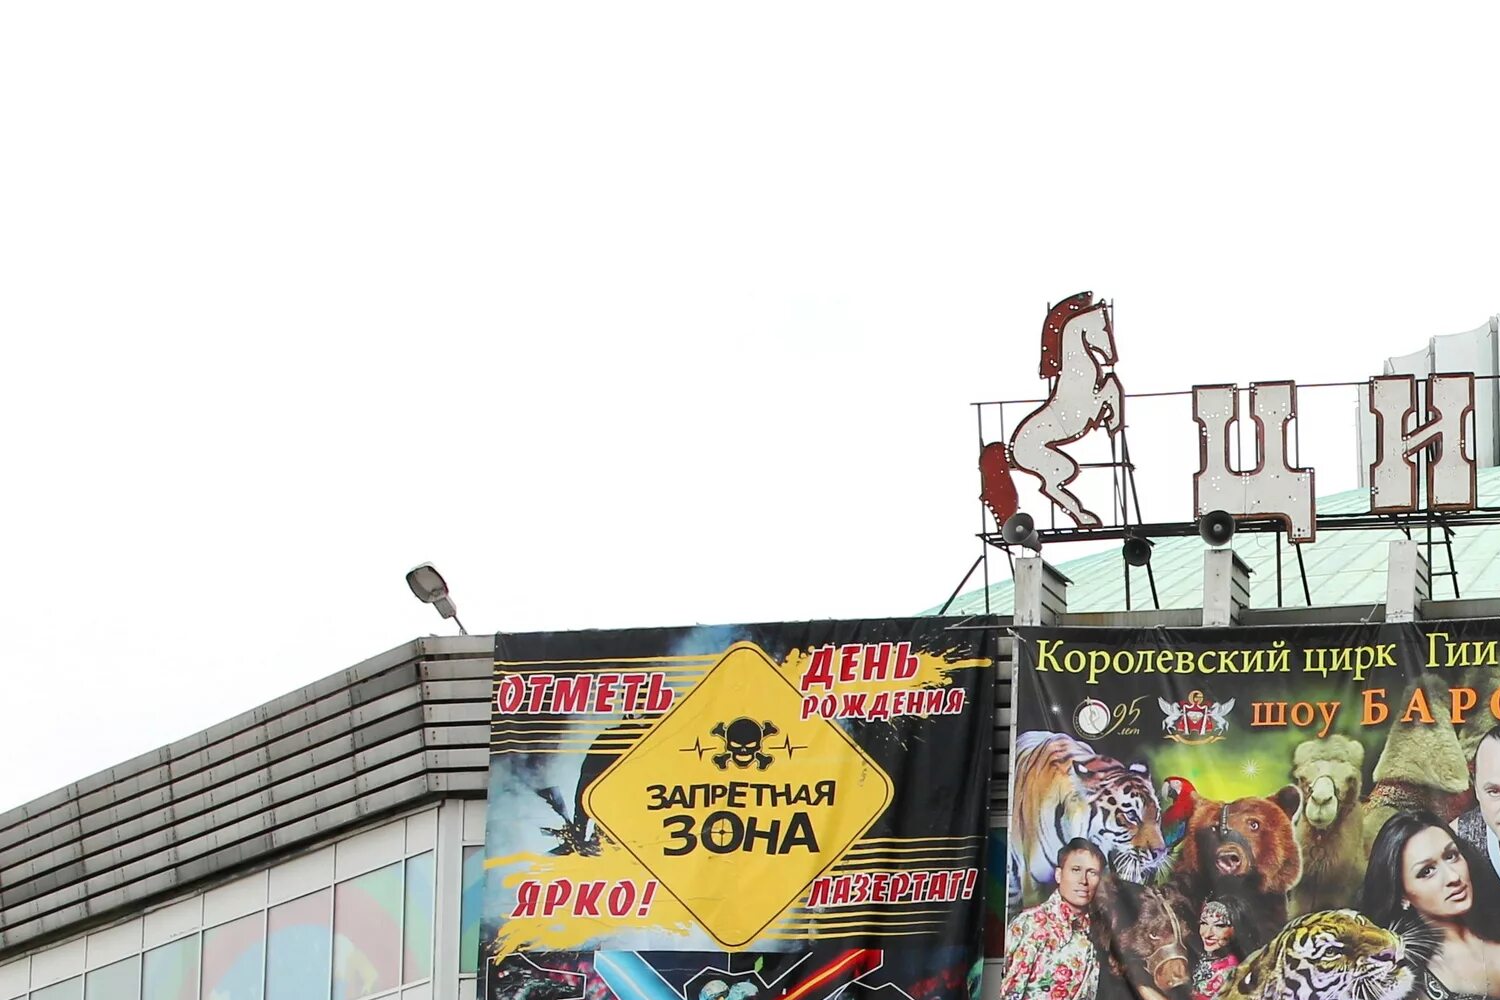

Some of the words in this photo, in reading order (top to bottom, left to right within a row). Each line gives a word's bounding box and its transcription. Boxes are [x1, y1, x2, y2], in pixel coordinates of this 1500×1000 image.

[800, 642, 920, 690] ДЕНЬ
[1035, 638, 1291, 685] Королевский
[1302, 642, 1397, 681] цирк
[1425, 632, 1498, 668] Гии
[497, 672, 675, 715] ОТМЕТЬ
[800, 687, 966, 722] РОЖДЕНИЯ
[1106, 694, 1150, 734] 95
[1250, 701, 1341, 738] шоу
[647, 780, 837, 810] ЗАПРЕТНАЯ
[663, 812, 820, 856] ЗОНА
[510, 878, 659, 919] ЯРКО!
